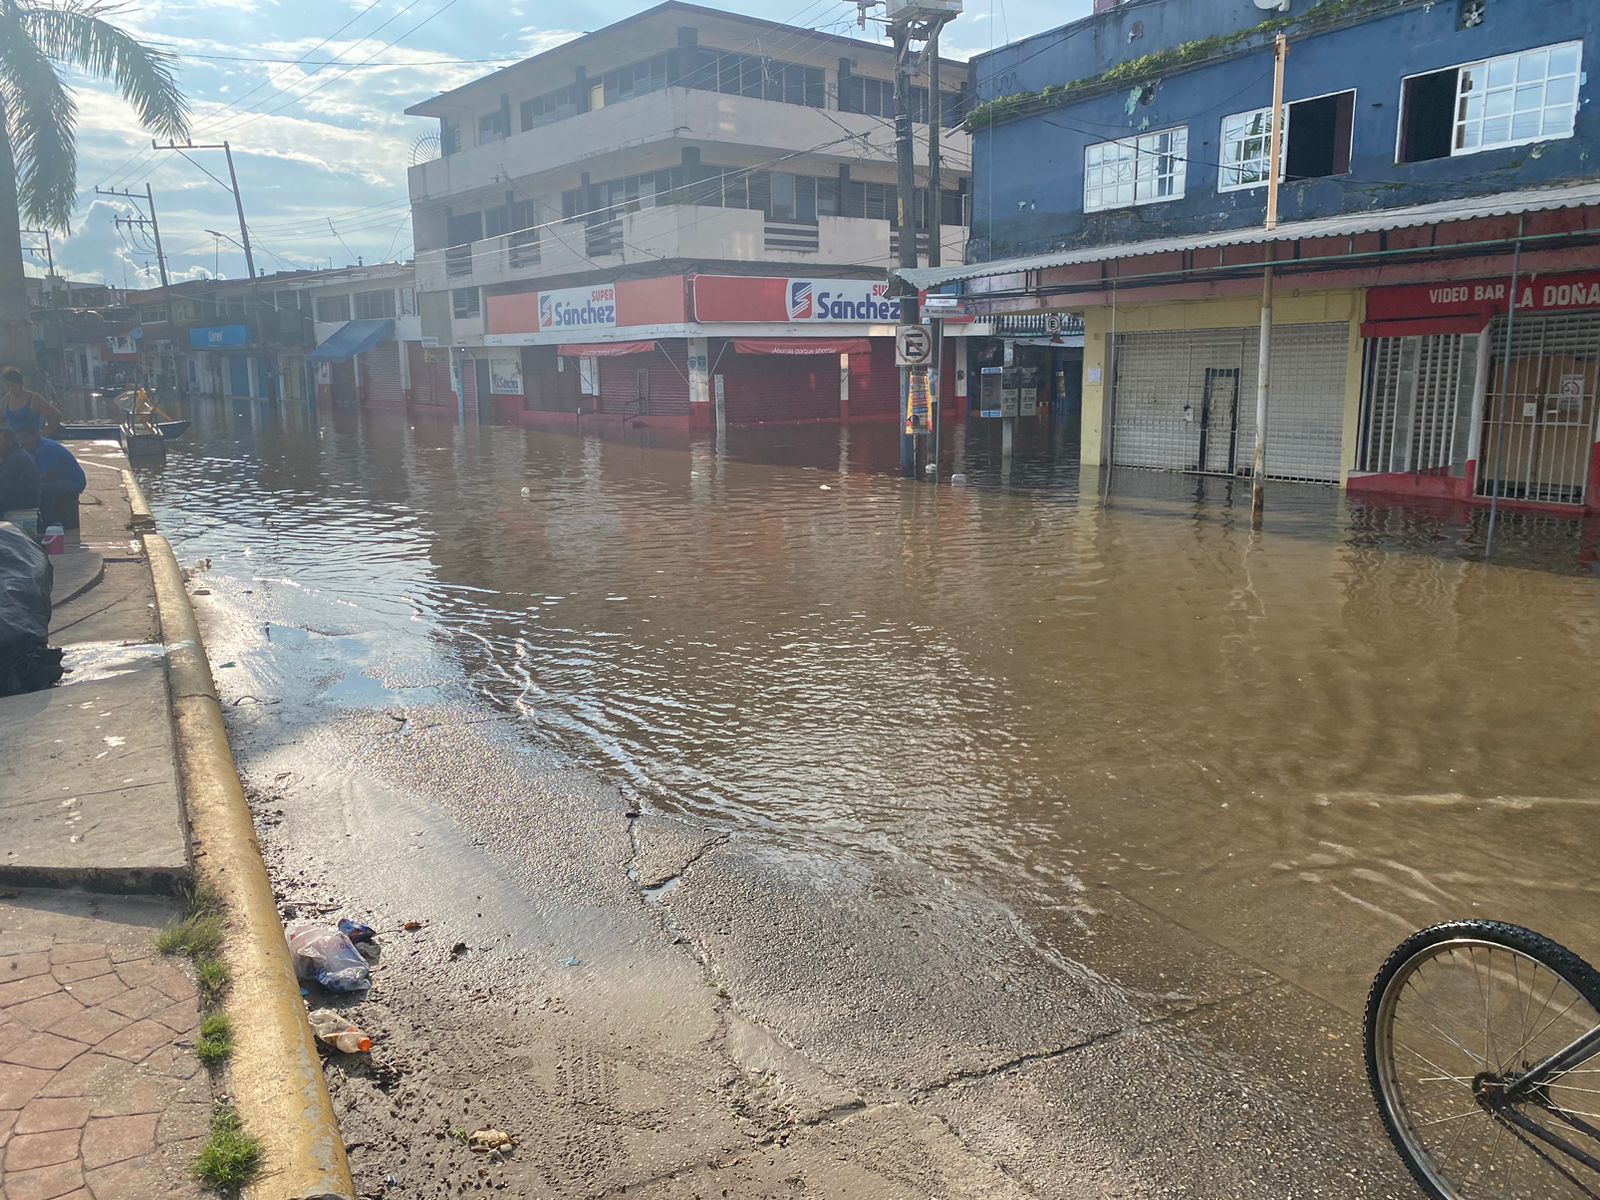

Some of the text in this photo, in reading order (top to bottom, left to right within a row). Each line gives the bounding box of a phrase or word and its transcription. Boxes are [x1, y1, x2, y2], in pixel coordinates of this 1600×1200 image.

[591, 288, 614, 302] SUPER
[817, 292, 900, 320] Sánchez
[1429, 286, 1469, 304] VIDEO
[1474, 284, 1505, 300] BAR
[1543, 282, 1600, 306] DOÑA
[554, 300, 615, 326] Sánchez
[905, 333, 923, 356] E
